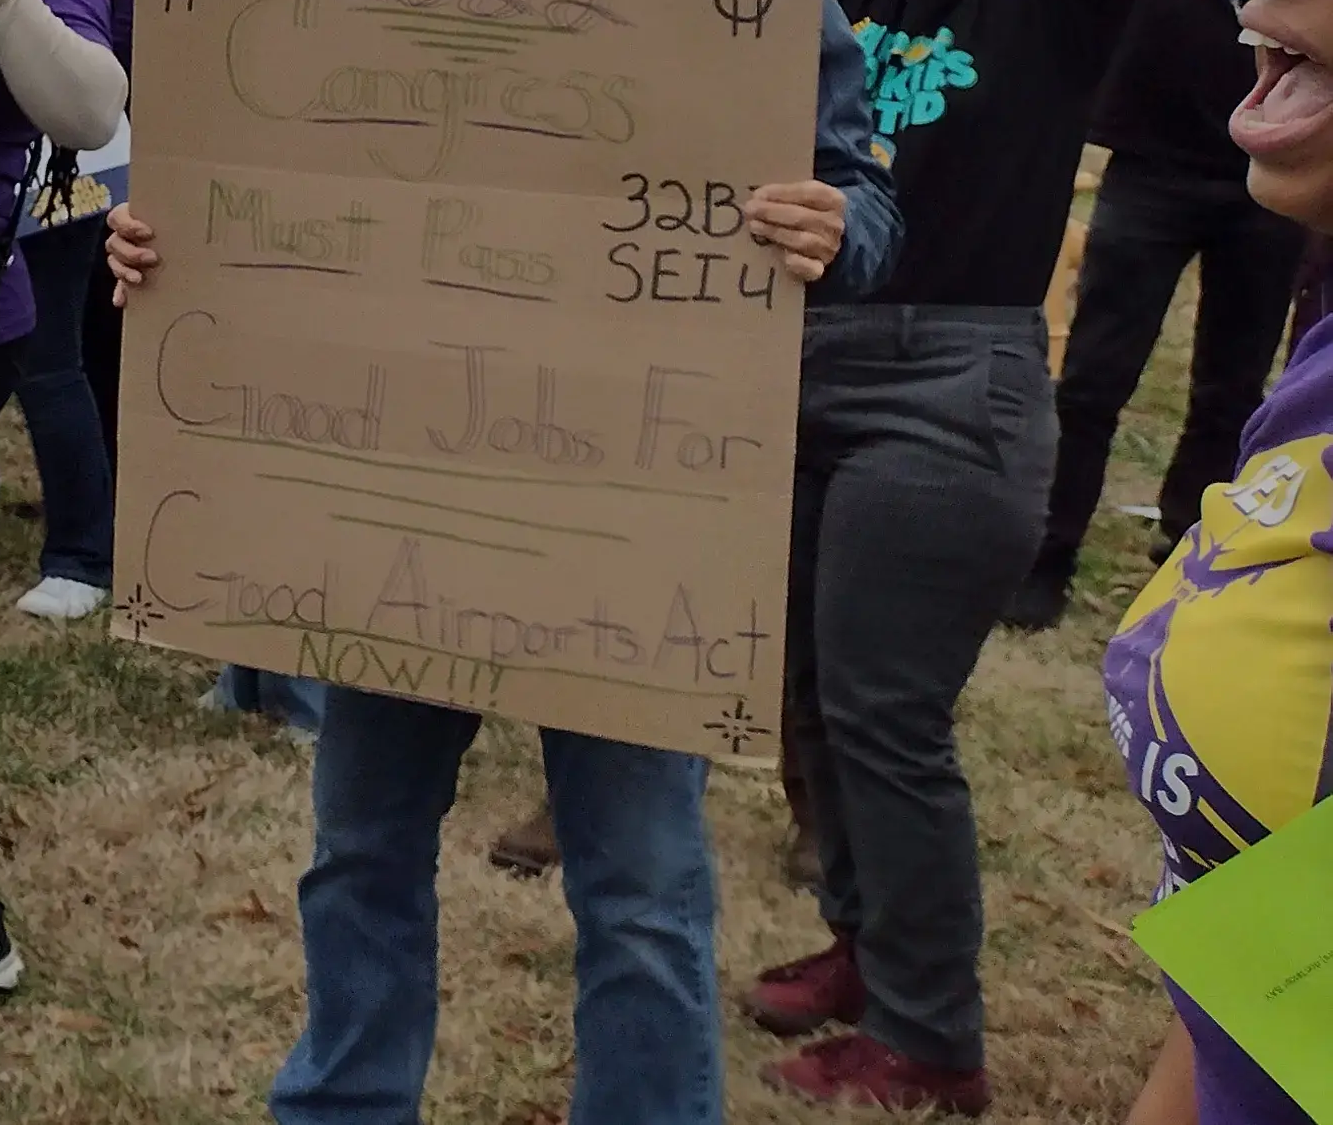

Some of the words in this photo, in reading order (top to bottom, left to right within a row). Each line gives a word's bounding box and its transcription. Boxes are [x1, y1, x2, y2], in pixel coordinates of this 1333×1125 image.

[205, 178, 384, 262] Must
[421, 197, 556, 287] Pass
[155, 310, 390, 452] Good
[424, 339, 606, 468] Jobs
[635, 362, 763, 472] For
[143, 488, 341, 629] Good
[365, 535, 647, 675] Airports
[651, 581, 773, 684] Act
